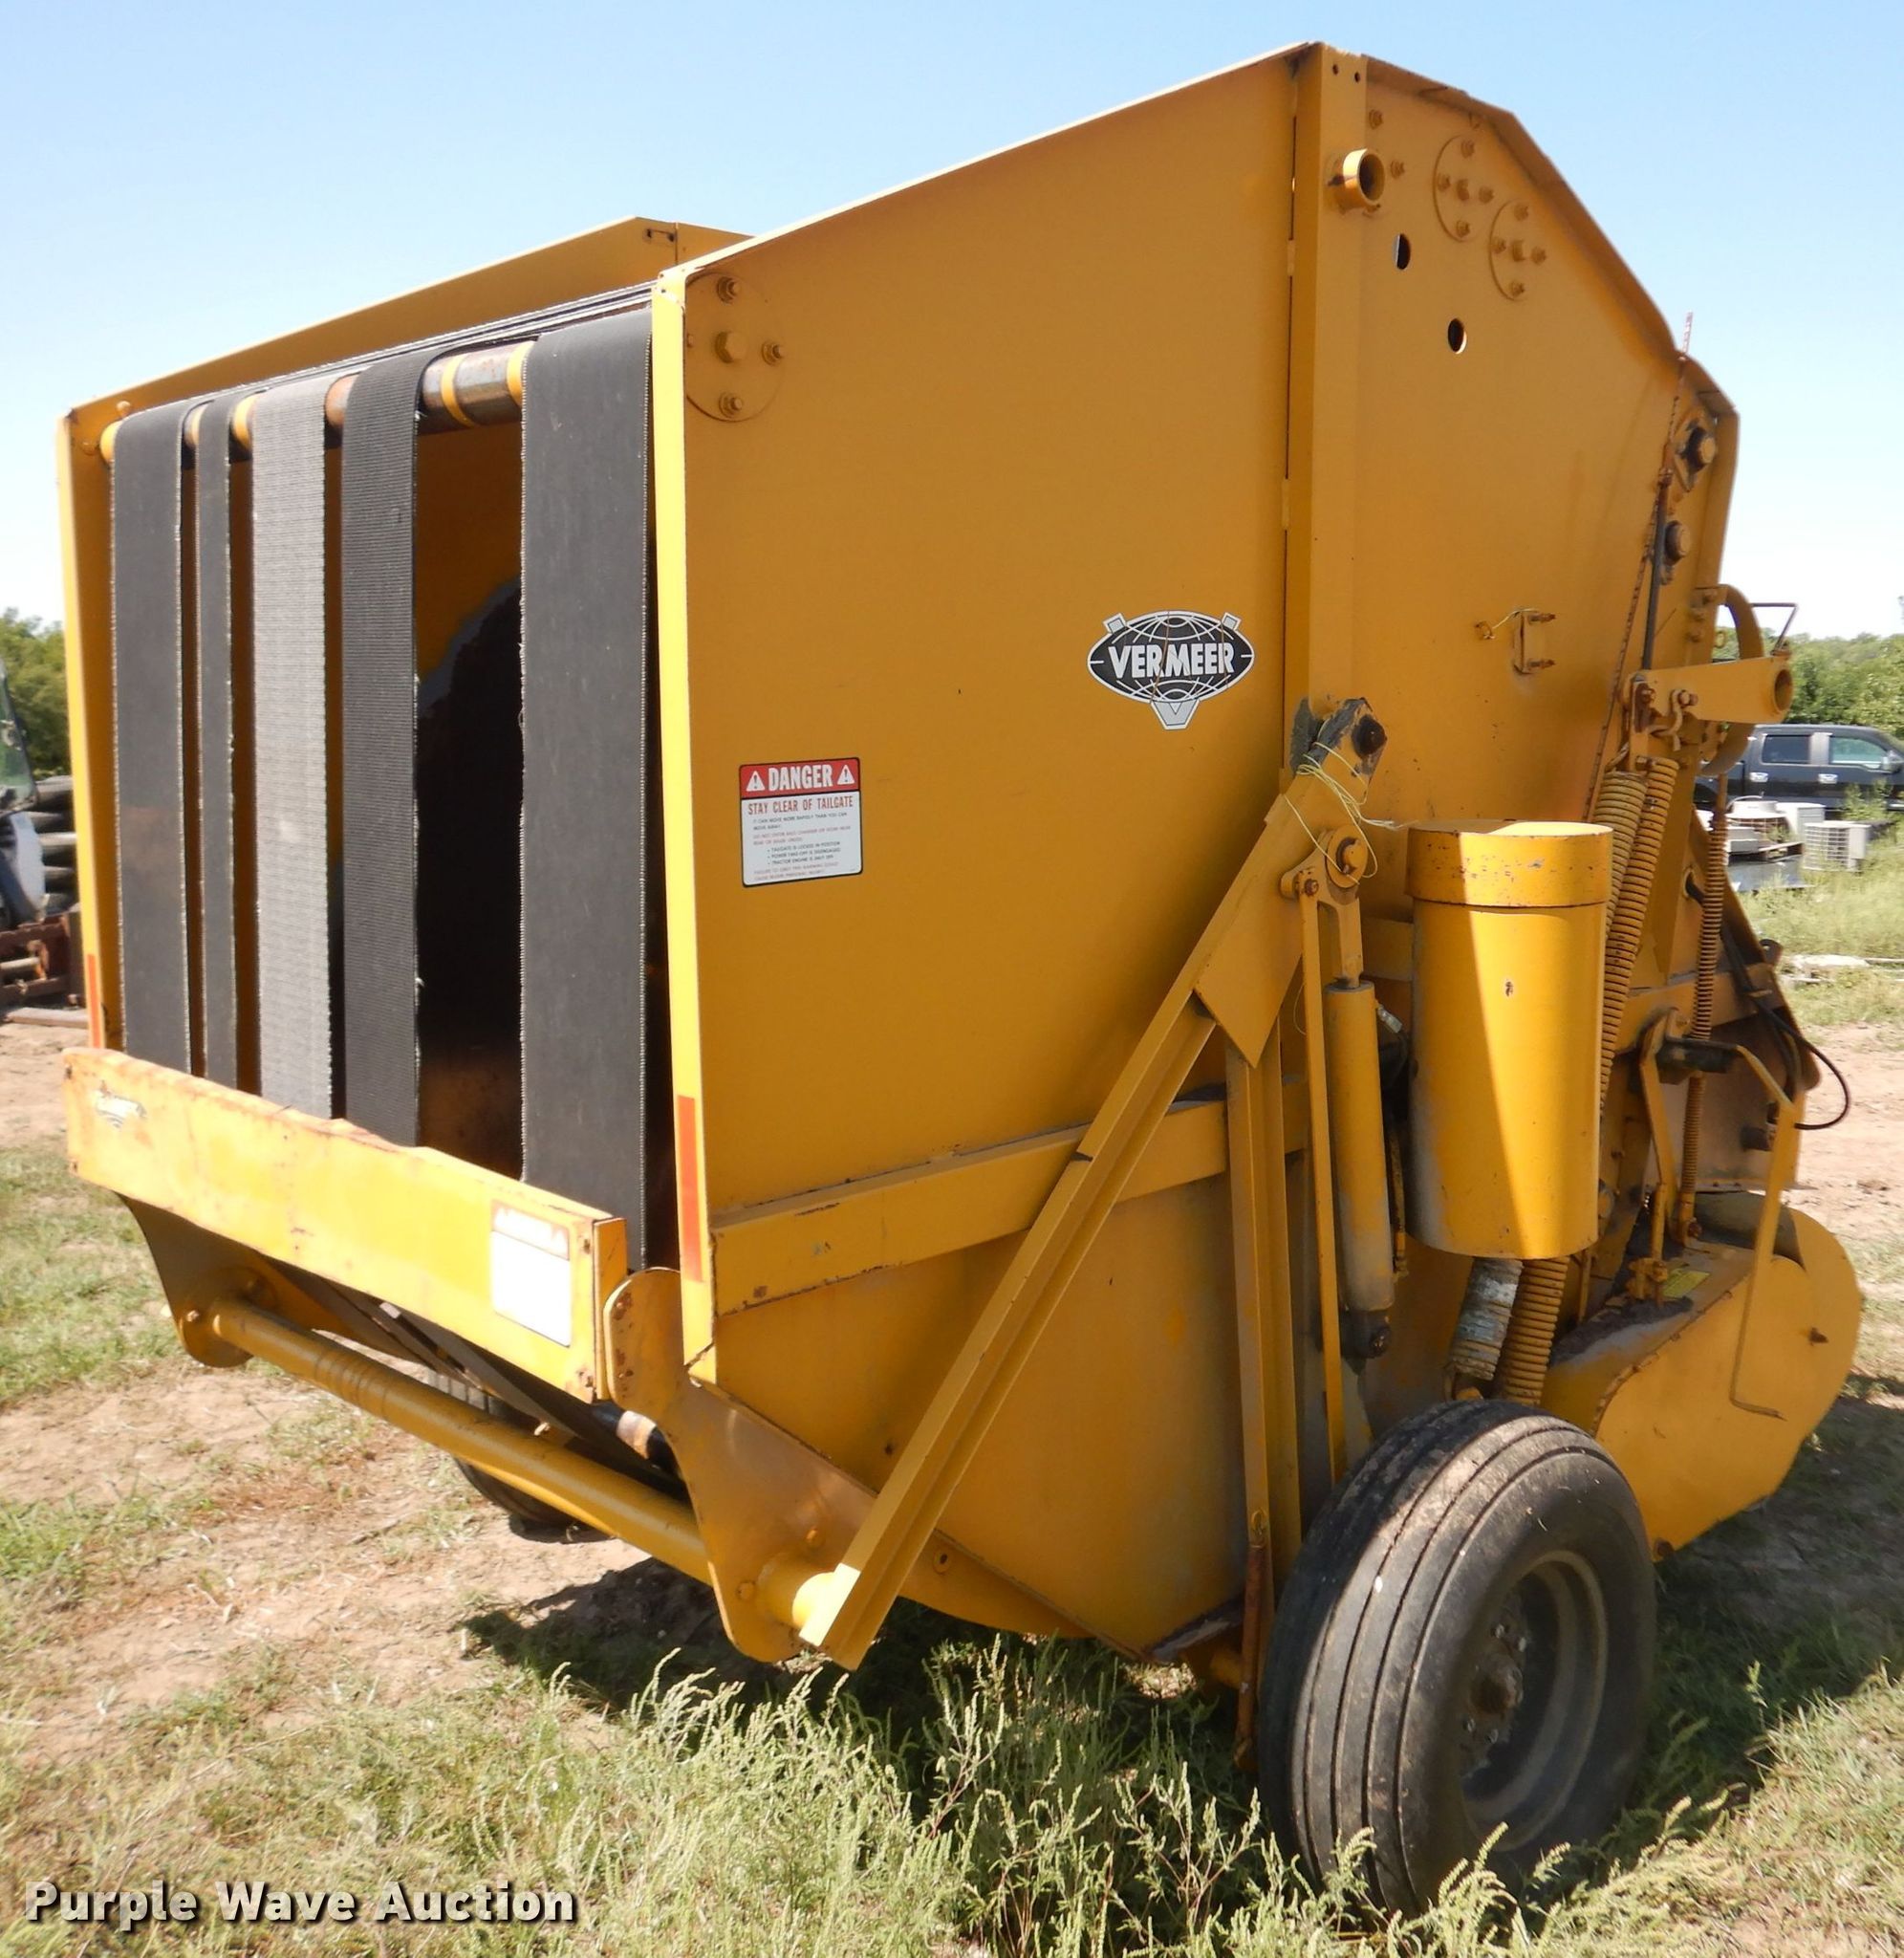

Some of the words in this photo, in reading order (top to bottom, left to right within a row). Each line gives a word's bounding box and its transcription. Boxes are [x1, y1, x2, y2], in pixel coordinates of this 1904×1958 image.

[1108, 642, 1235, 679] VERMEER
[768, 764, 833, 792] DANGER
[748, 802, 768, 816] STAY
[772, 799, 799, 813] CLEAR
[803, 797, 812, 811] OF
[817, 795, 854, 810] TAILGATE
